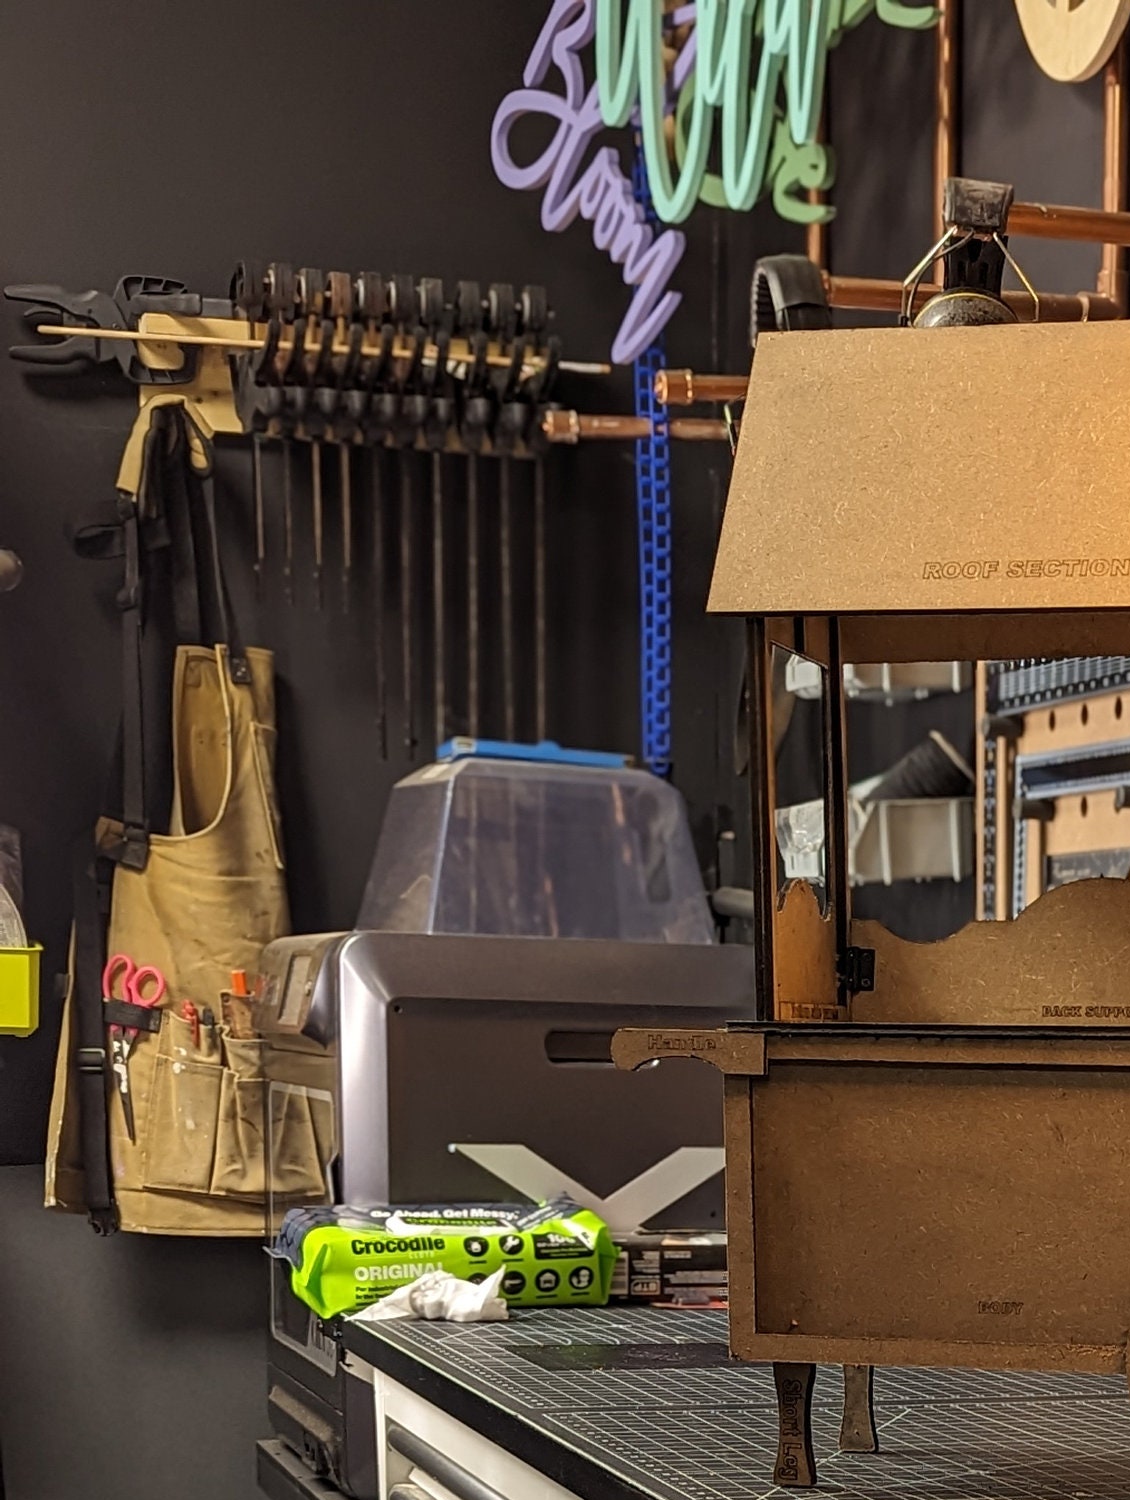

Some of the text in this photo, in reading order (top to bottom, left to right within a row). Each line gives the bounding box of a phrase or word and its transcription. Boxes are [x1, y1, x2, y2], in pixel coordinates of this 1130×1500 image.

[923, 557, 1130, 579] ROOF SECTION
[1042, 1005, 1082, 1017] BACK
[648, 1034, 716, 1050] Handle
[351, 1237, 445, 1255] Crocodile
[978, 1301, 1024, 1315] BODY
[778, 1380, 802, 1480] Short Leg
